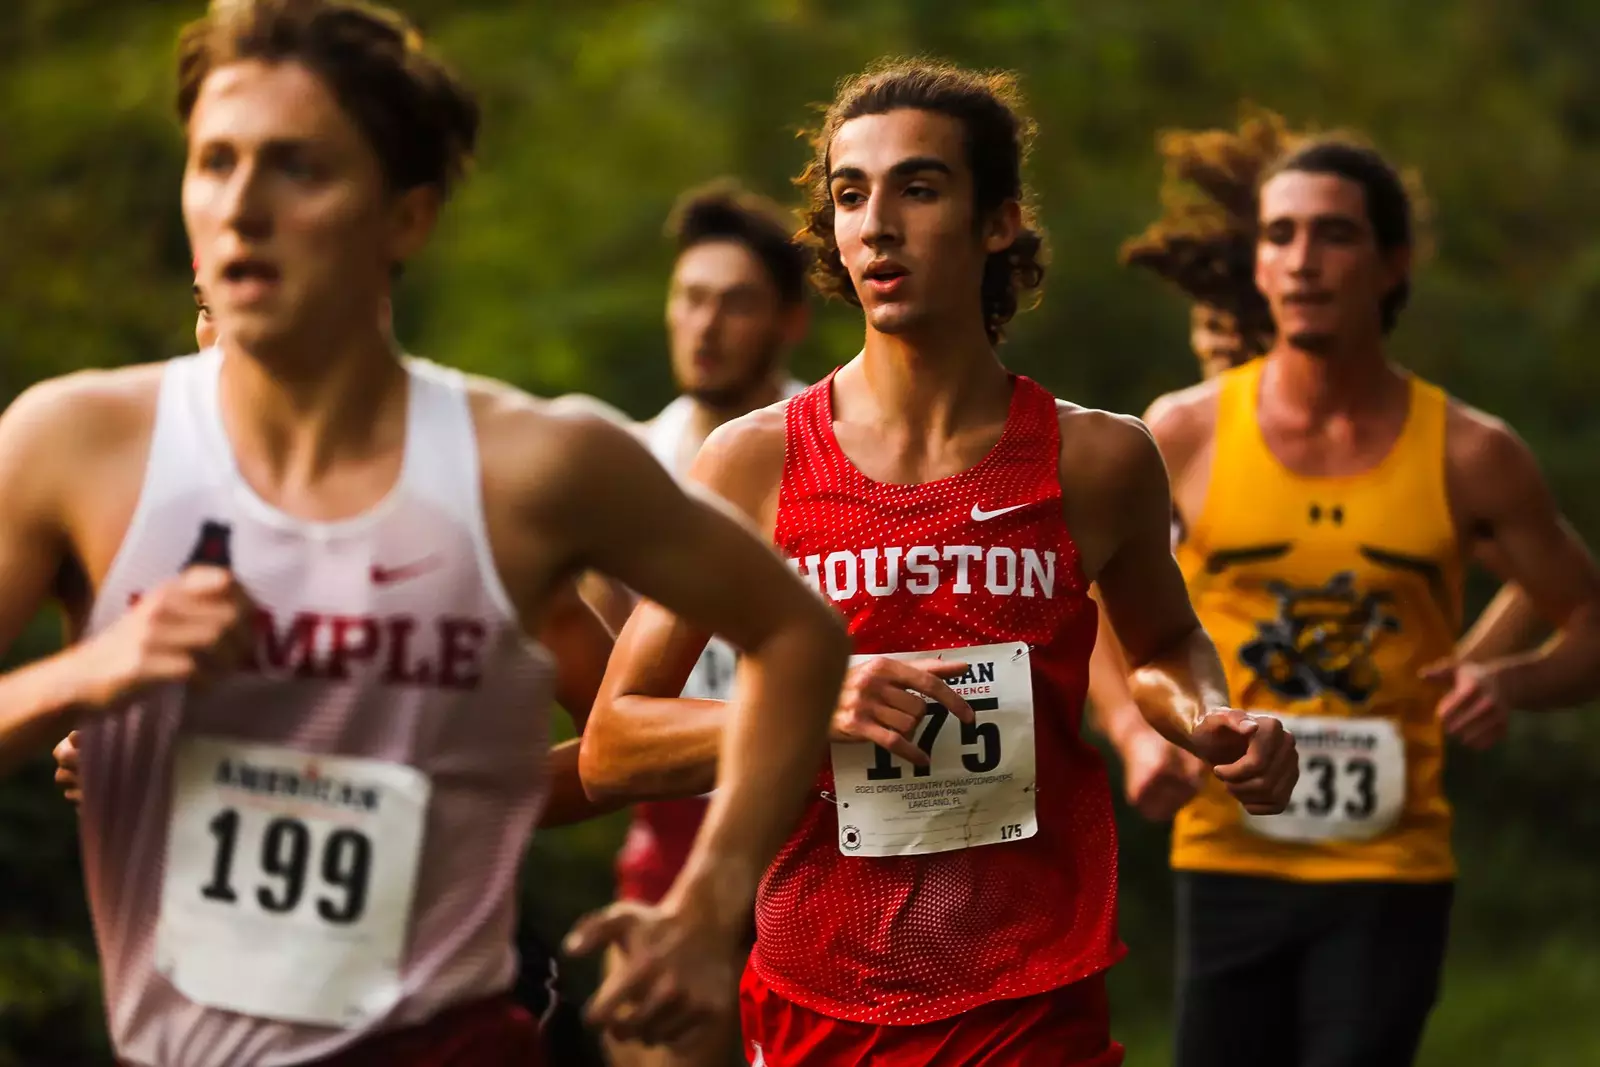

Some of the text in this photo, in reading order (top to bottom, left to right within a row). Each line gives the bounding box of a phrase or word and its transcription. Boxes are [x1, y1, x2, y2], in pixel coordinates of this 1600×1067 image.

[788, 545, 1056, 600] HOUSTON
[238, 605, 486, 690] MPLE
[855, 773, 1013, 794] 2021 CROSS COUNTRY CHAMPIONSHIPS
[902, 787, 968, 800] HOLLOWAY PARK
[1286, 754, 1378, 820] 33
[1001, 823, 1022, 840] 175
[199, 807, 373, 925] 199
